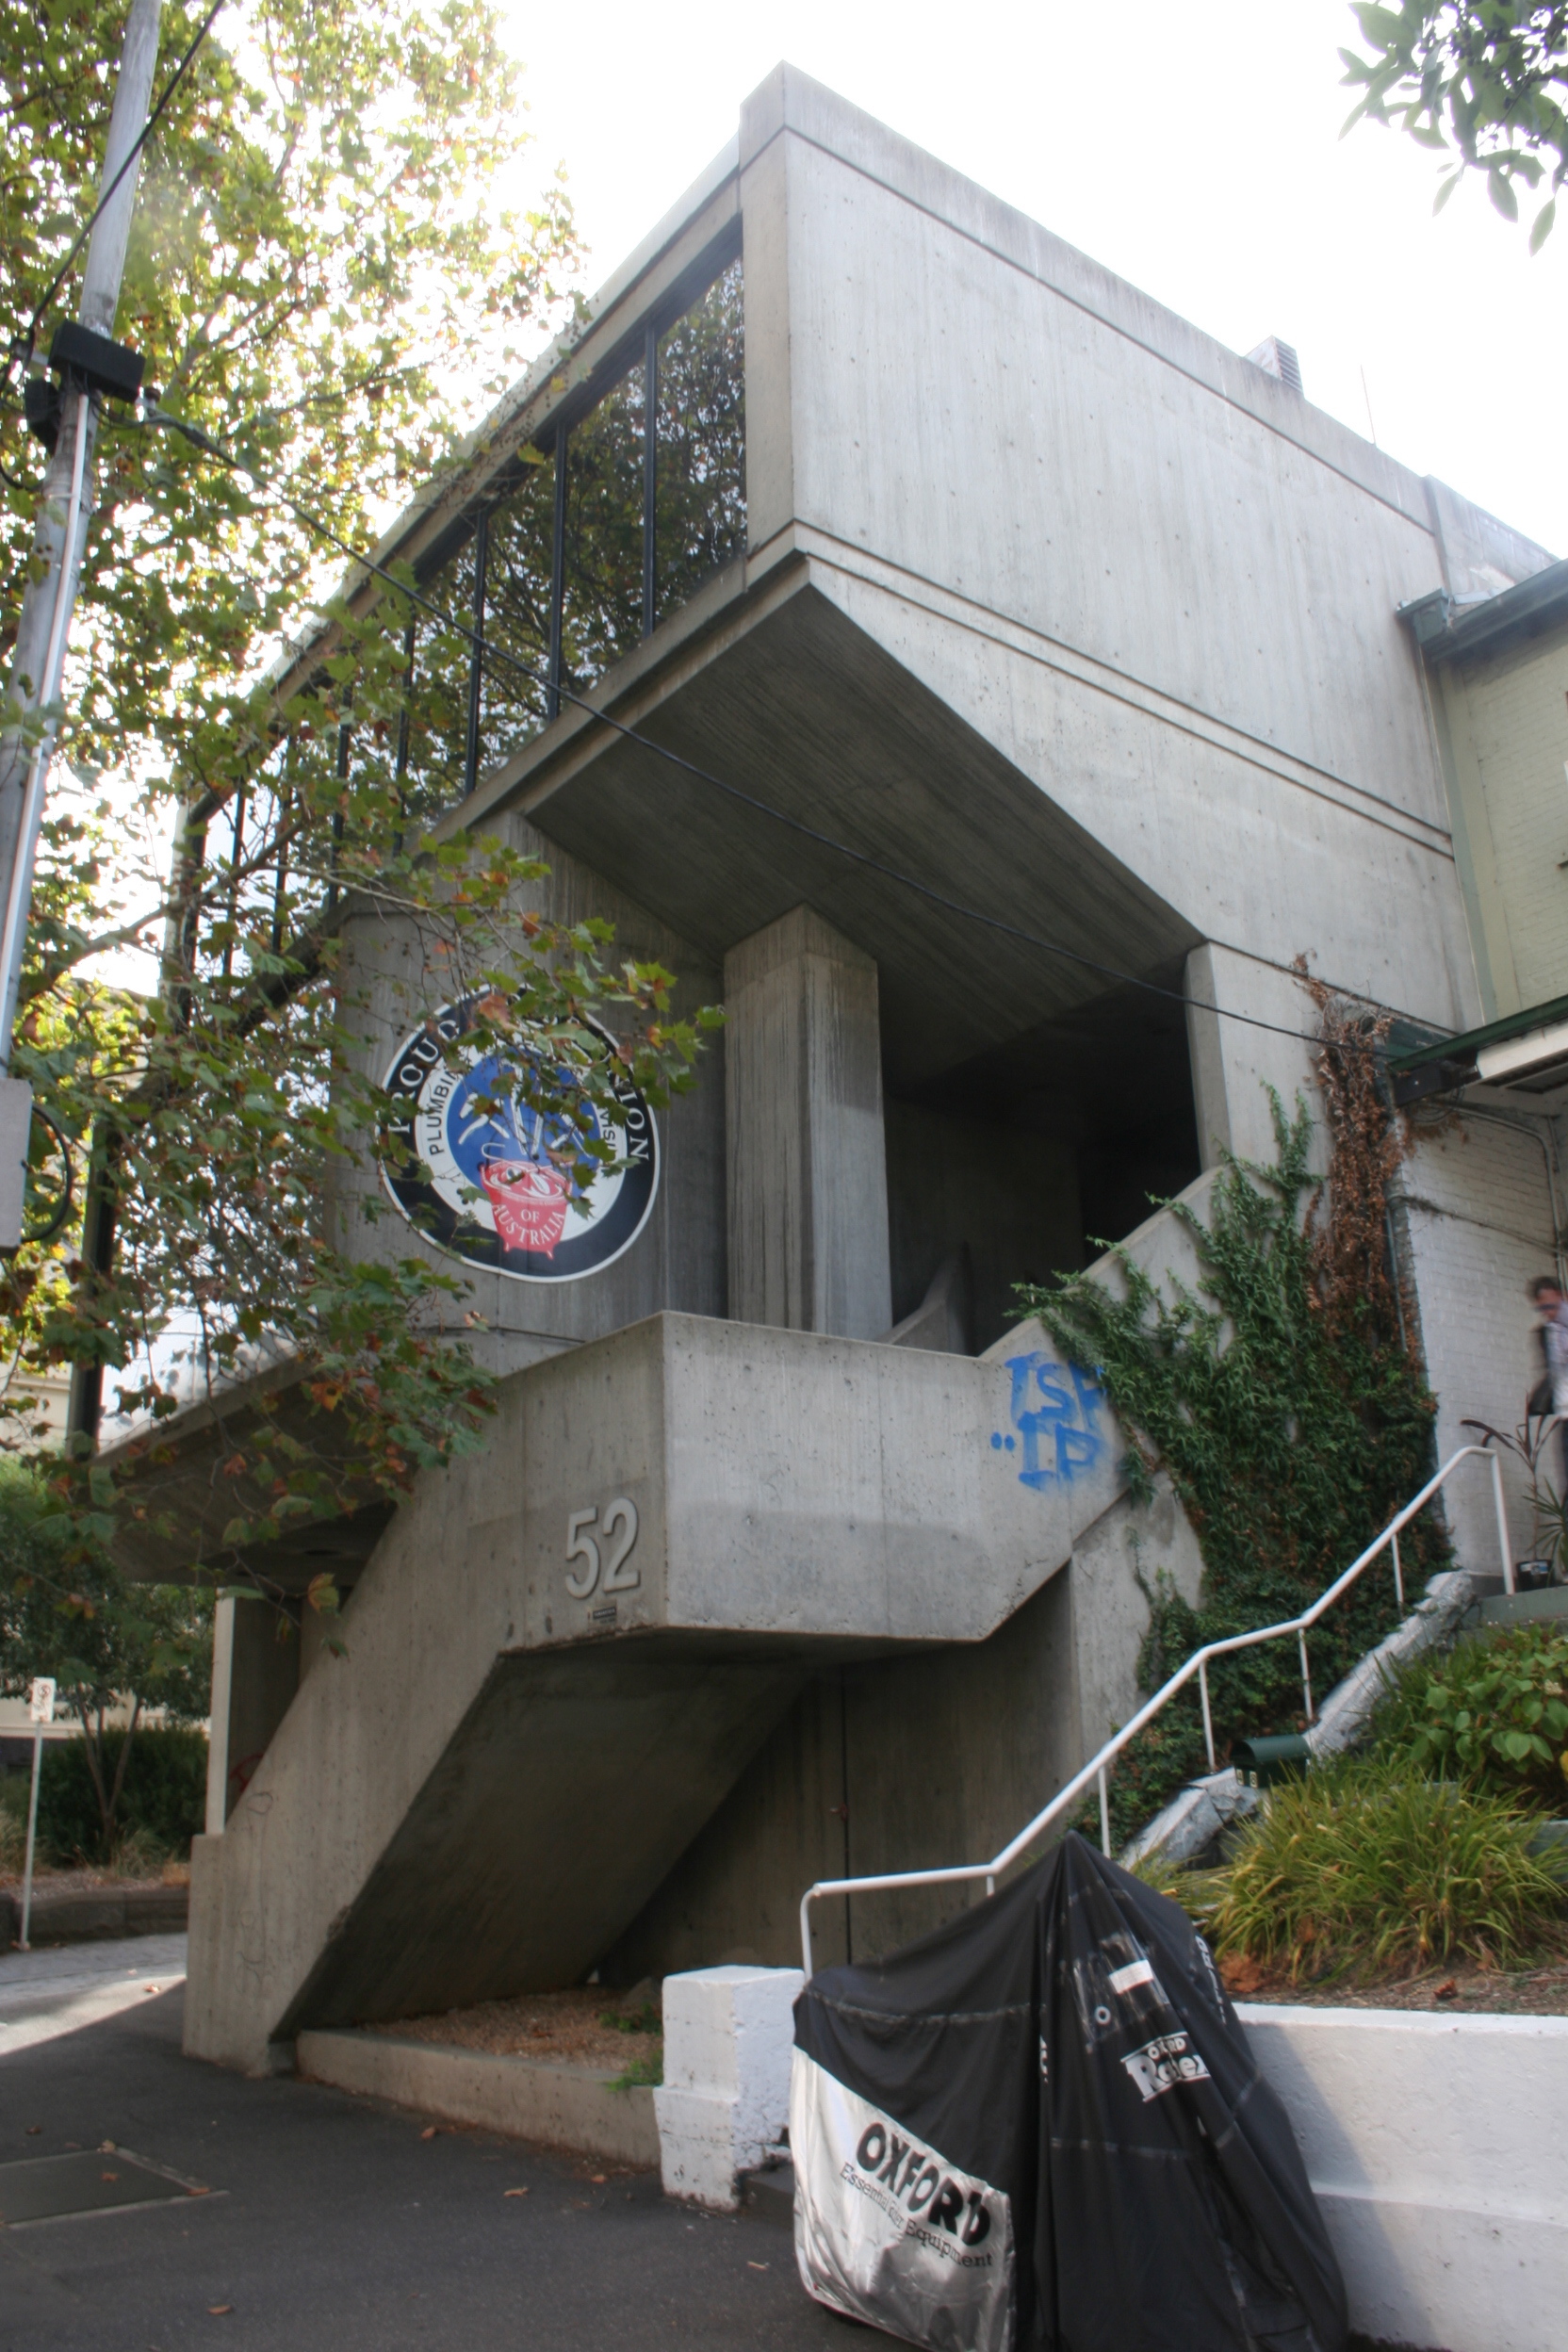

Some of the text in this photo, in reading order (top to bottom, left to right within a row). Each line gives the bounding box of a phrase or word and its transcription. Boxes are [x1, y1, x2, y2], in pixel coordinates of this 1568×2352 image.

[492, 1204, 565, 1246] AUSTRALIA
[520, 1208, 540, 1223] OF
[565, 1497, 640, 1600] 52
[857, 2121, 990, 2246] OXFORD
[905, 2217, 992, 2267] Equipment
